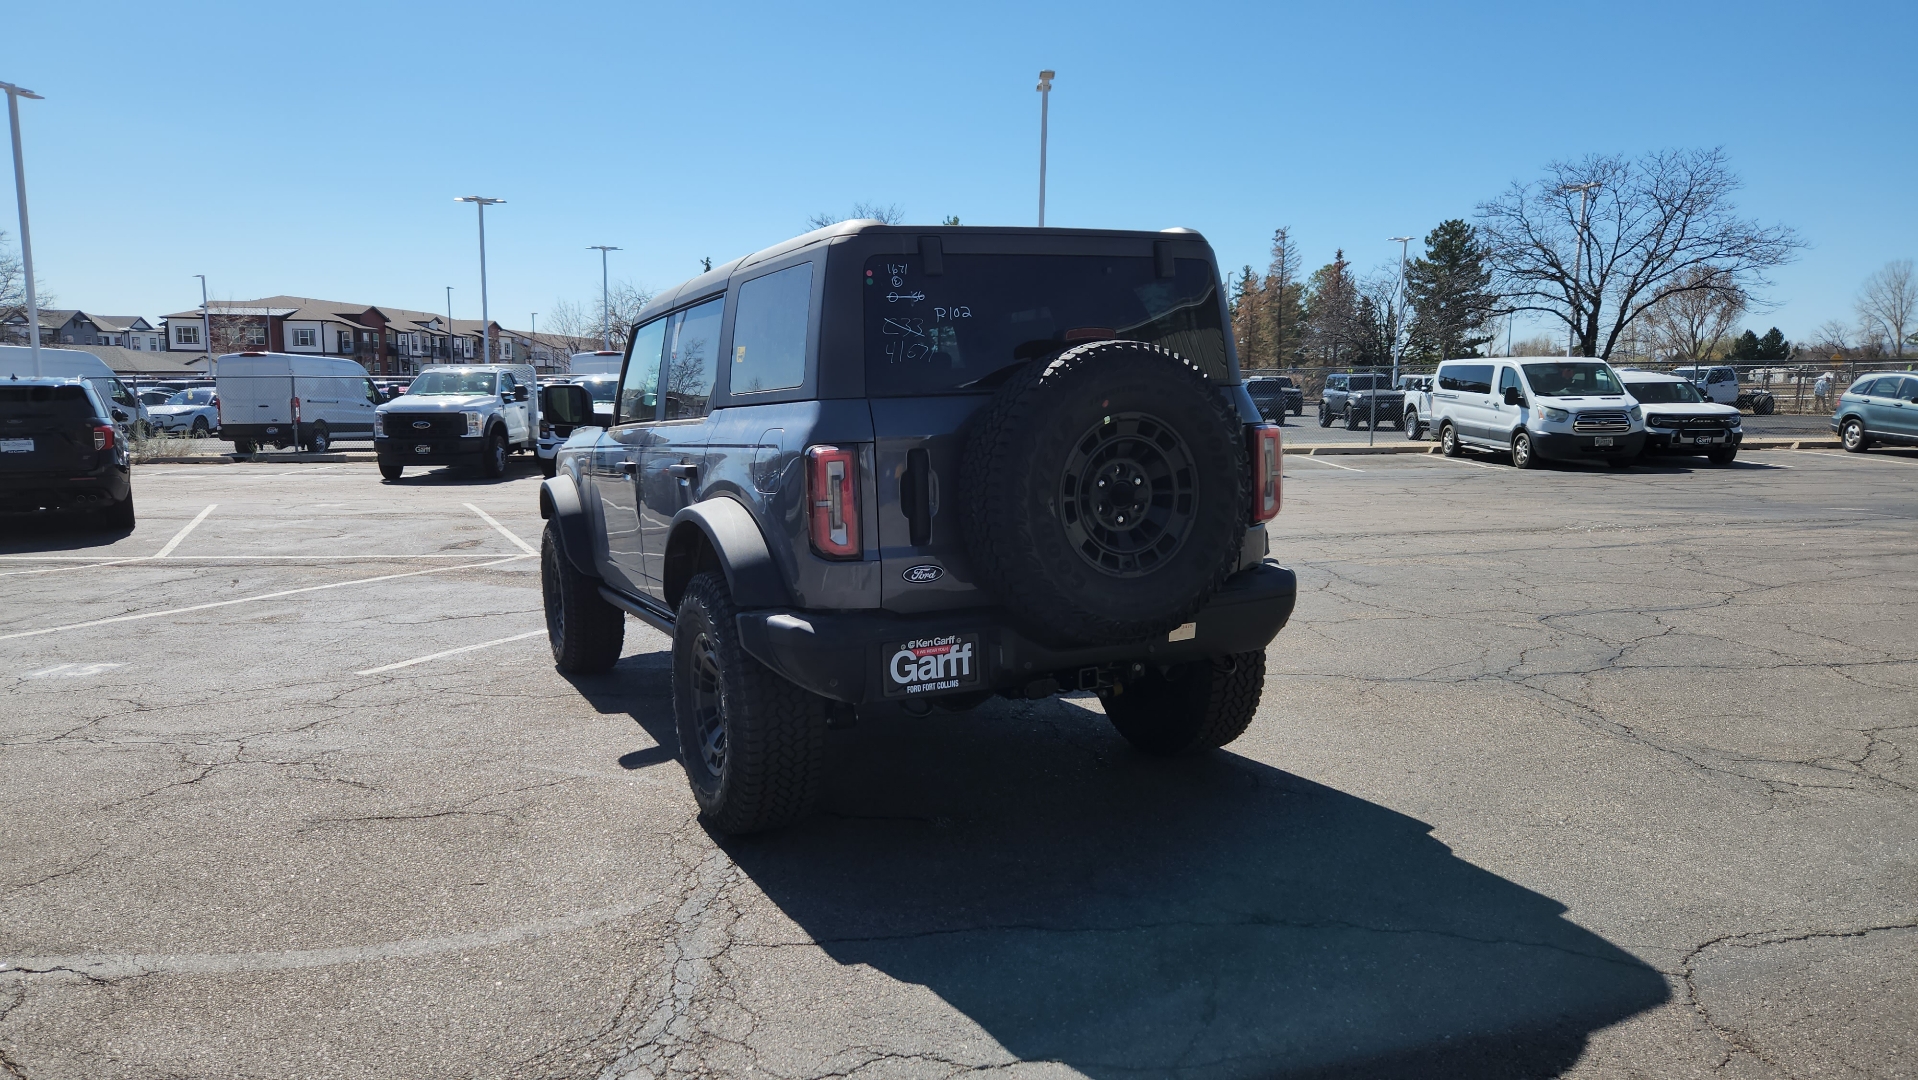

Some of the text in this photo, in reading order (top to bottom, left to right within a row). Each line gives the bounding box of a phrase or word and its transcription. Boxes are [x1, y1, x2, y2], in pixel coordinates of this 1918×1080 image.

[911, 567, 937, 580] Ford
[916, 635, 956, 649] Ken Garff
[889, 642, 972, 684] Garff
[906, 679, 959, 694] FORD FORT COLLINS
